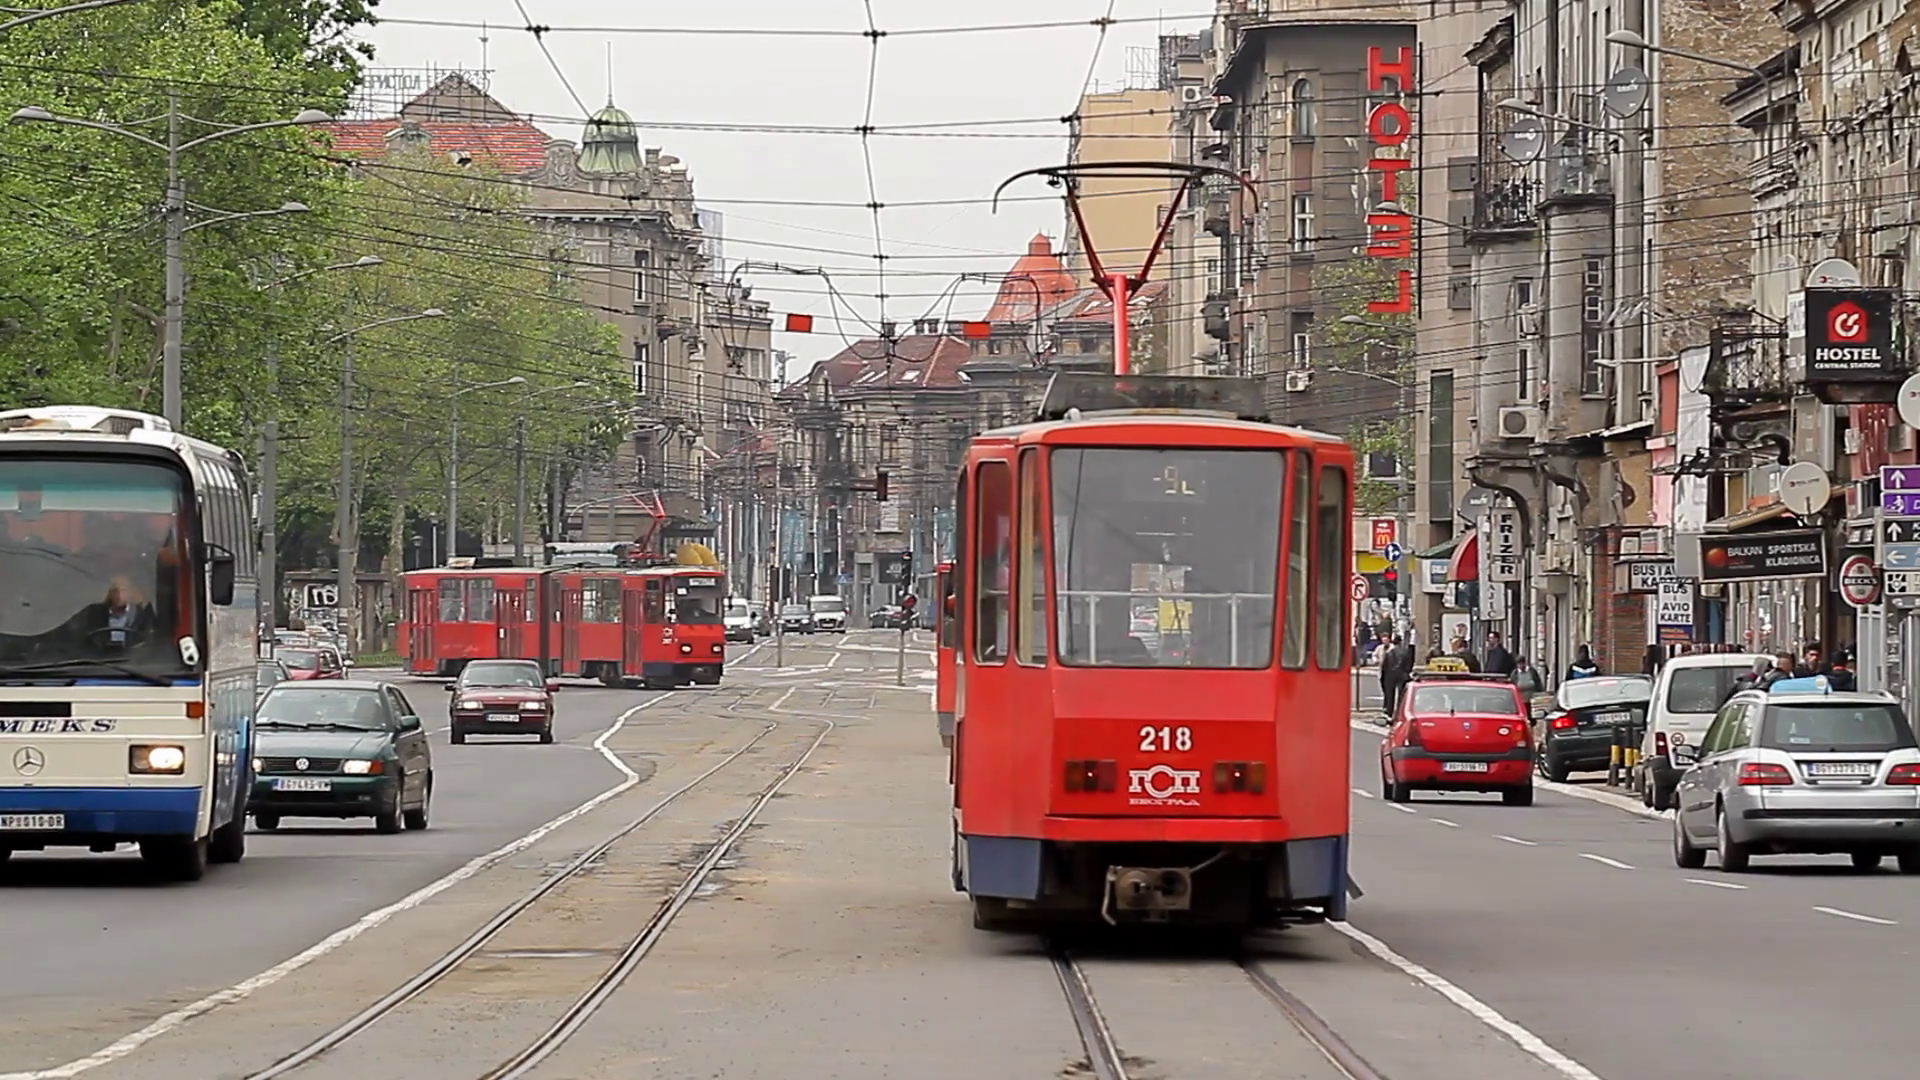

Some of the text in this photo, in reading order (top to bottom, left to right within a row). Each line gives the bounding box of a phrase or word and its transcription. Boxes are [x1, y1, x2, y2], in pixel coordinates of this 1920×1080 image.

[1816, 348, 1881, 360] HOSTEL
[1500, 514, 1514, 575] FRIZER
[1768, 543, 1816, 555] SPORTSKA
[1727, 546, 1763, 557] BALKAN
[1765, 555, 1821, 567] KLADIONICA
[1633, 565, 1655, 576] BUS
[1663, 585, 1688, 594] BUS
[1662, 602, 1690, 611] AVIO
[1660, 613, 1691, 623] KARTE
[1140, 726, 1192, 751] 218
